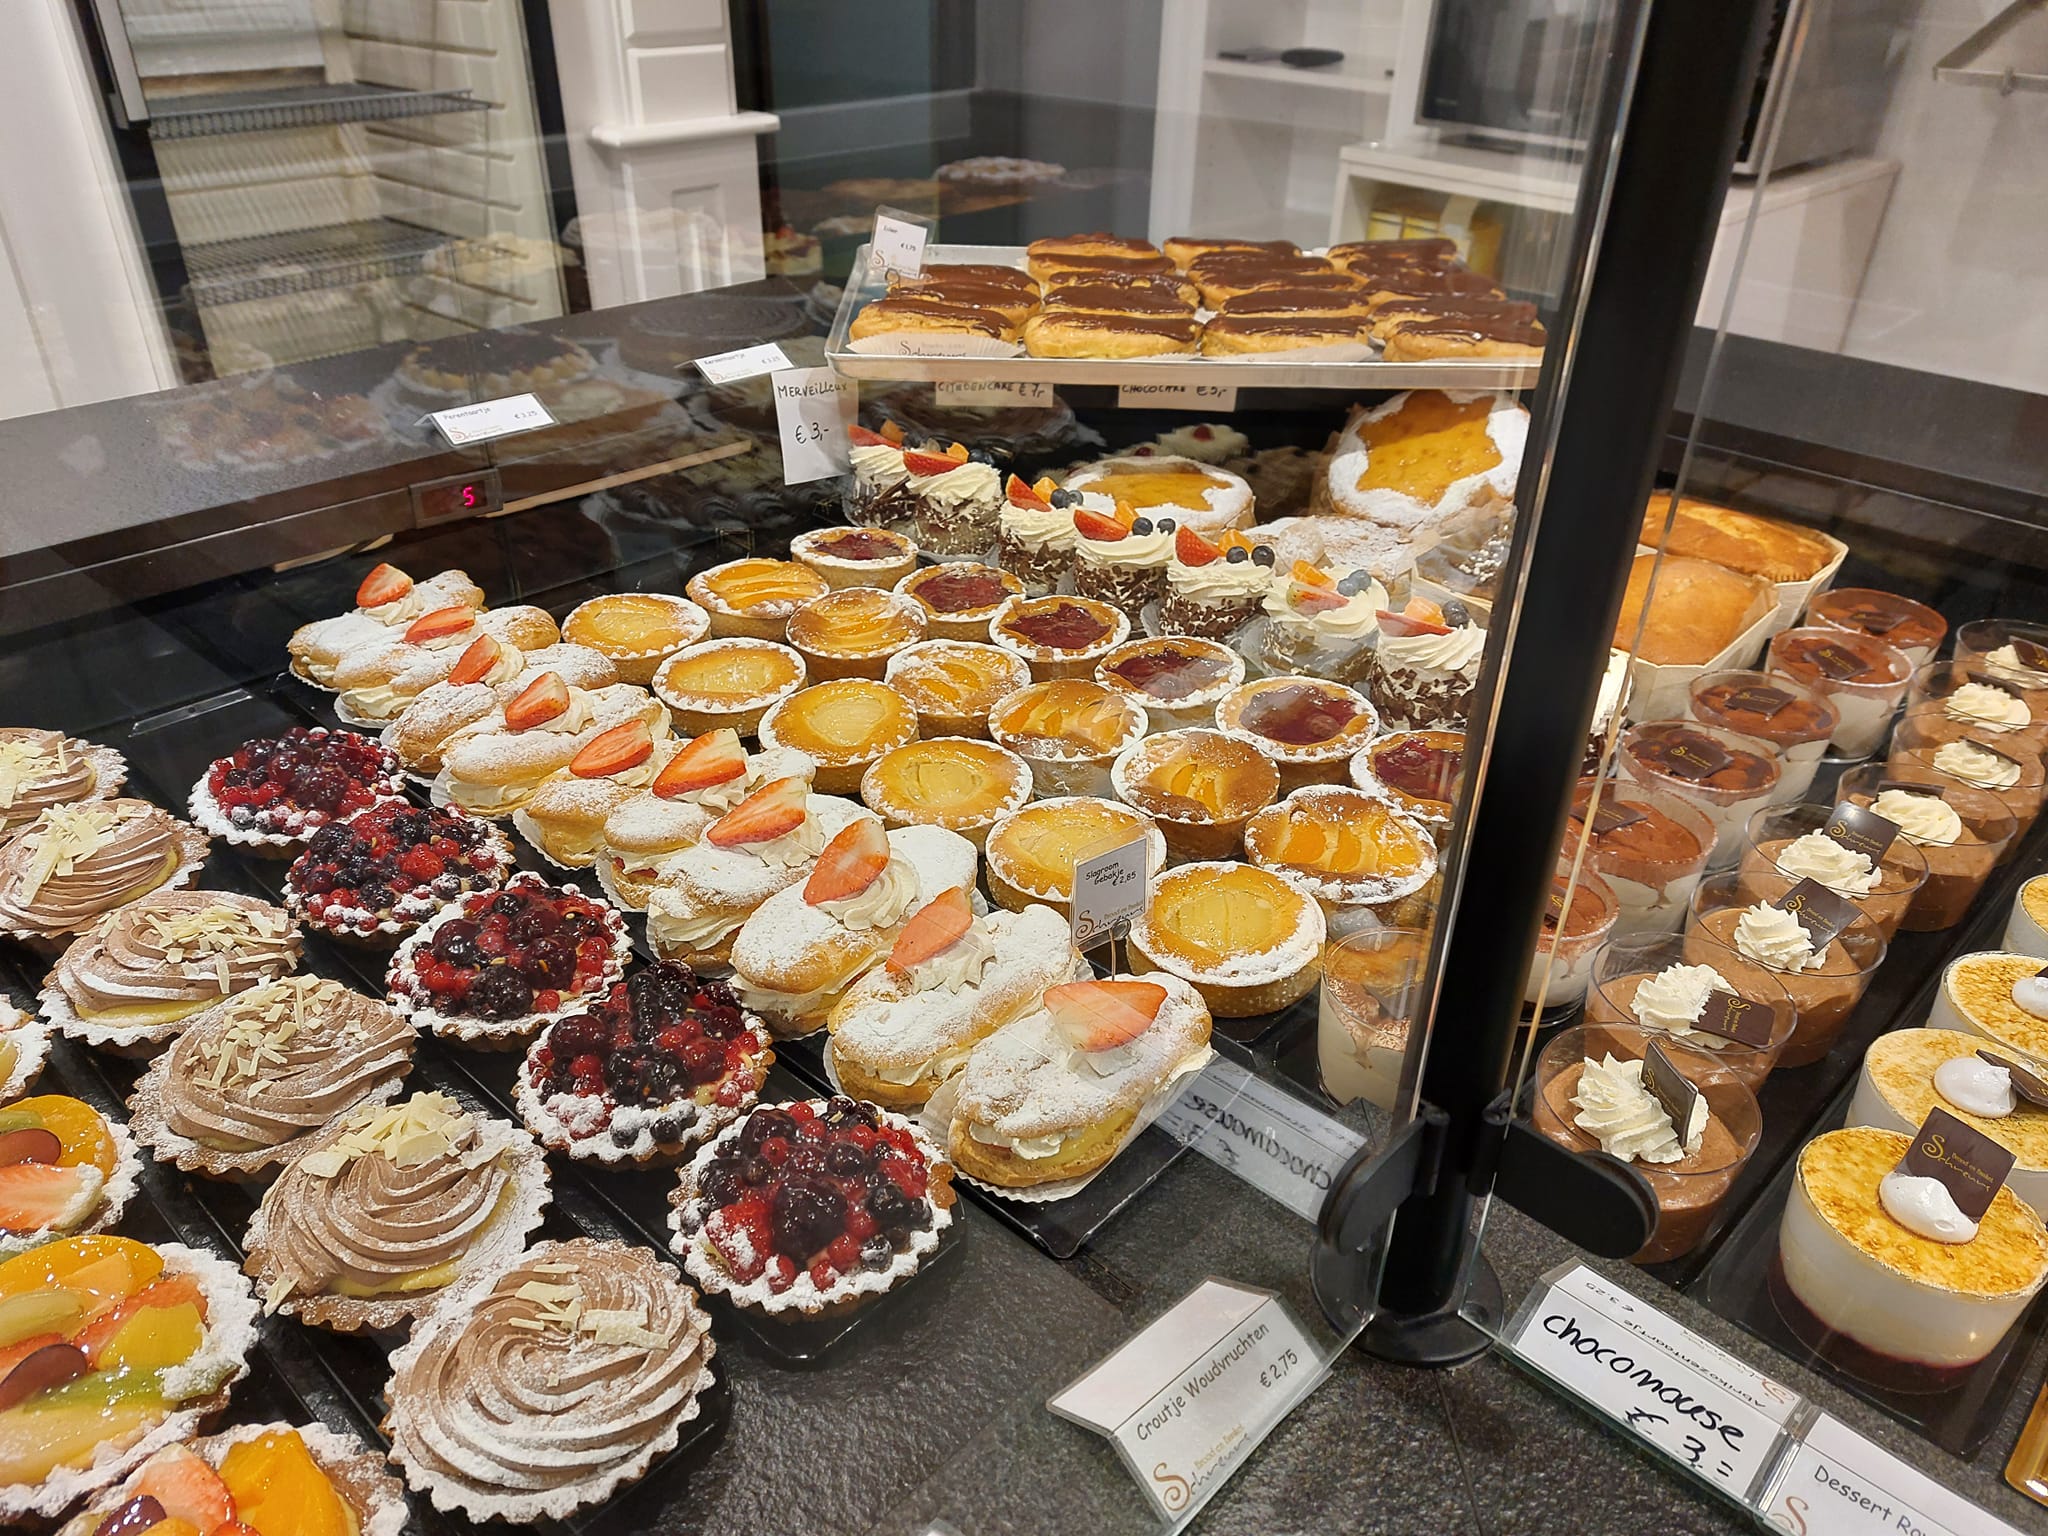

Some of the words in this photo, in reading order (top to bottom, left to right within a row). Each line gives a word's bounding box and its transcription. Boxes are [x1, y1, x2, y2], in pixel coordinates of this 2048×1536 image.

[795, 424, 807, 444] €
[1085, 862, 1119, 881] Slagroom
[1094, 868, 1124, 885] Gebakje
[1136, 1394, 1186, 1440] Croutje
[1183, 1323, 1270, 1398] Woudvruchten
[1260, 1371, 1272, 1388] €
[1270, 1348, 1298, 1380] 2,75
[1814, 1464, 1893, 1521] Dessert
[1896, 1514, 1926, 1536] Ro
